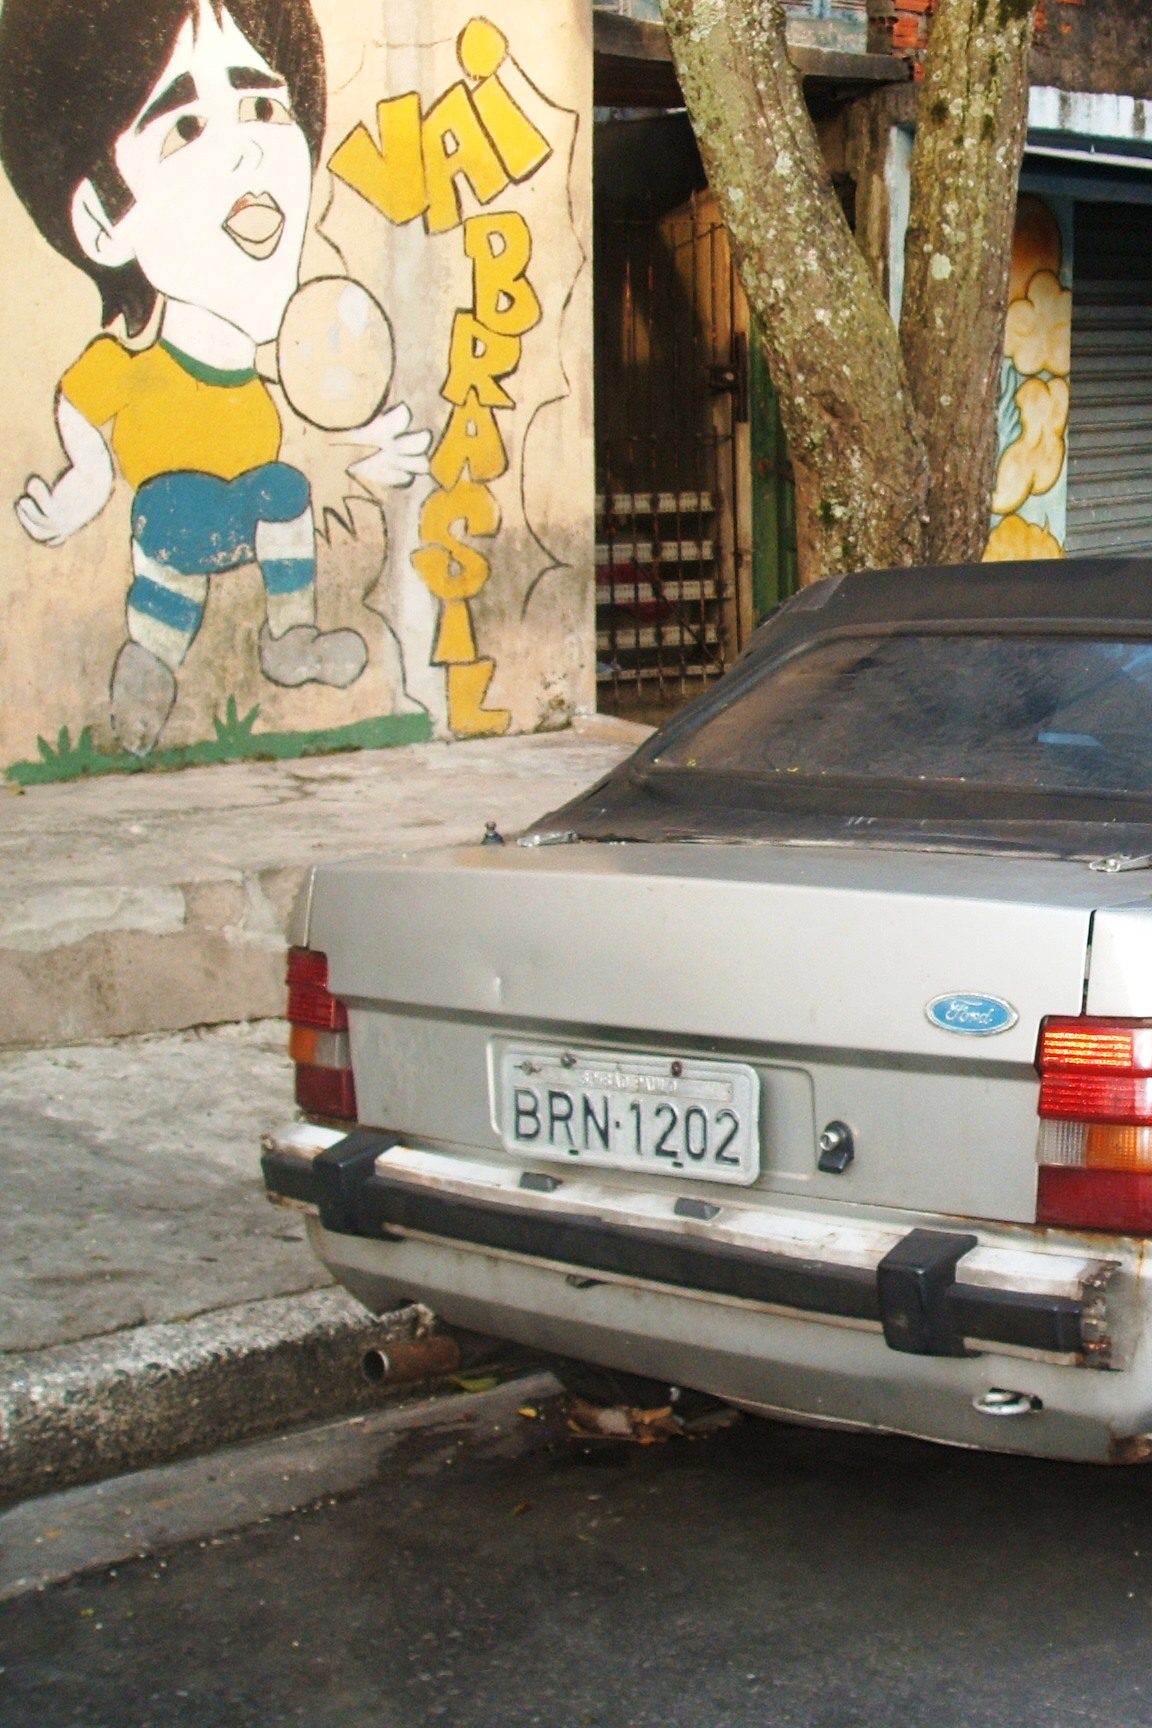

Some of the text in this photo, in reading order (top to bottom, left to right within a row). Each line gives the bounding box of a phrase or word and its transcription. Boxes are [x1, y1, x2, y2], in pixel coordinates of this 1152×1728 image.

[328, 16, 553, 234] VAI
[411, 210, 543, 737] BRASIL
[945, 999, 995, 1025] Ford
